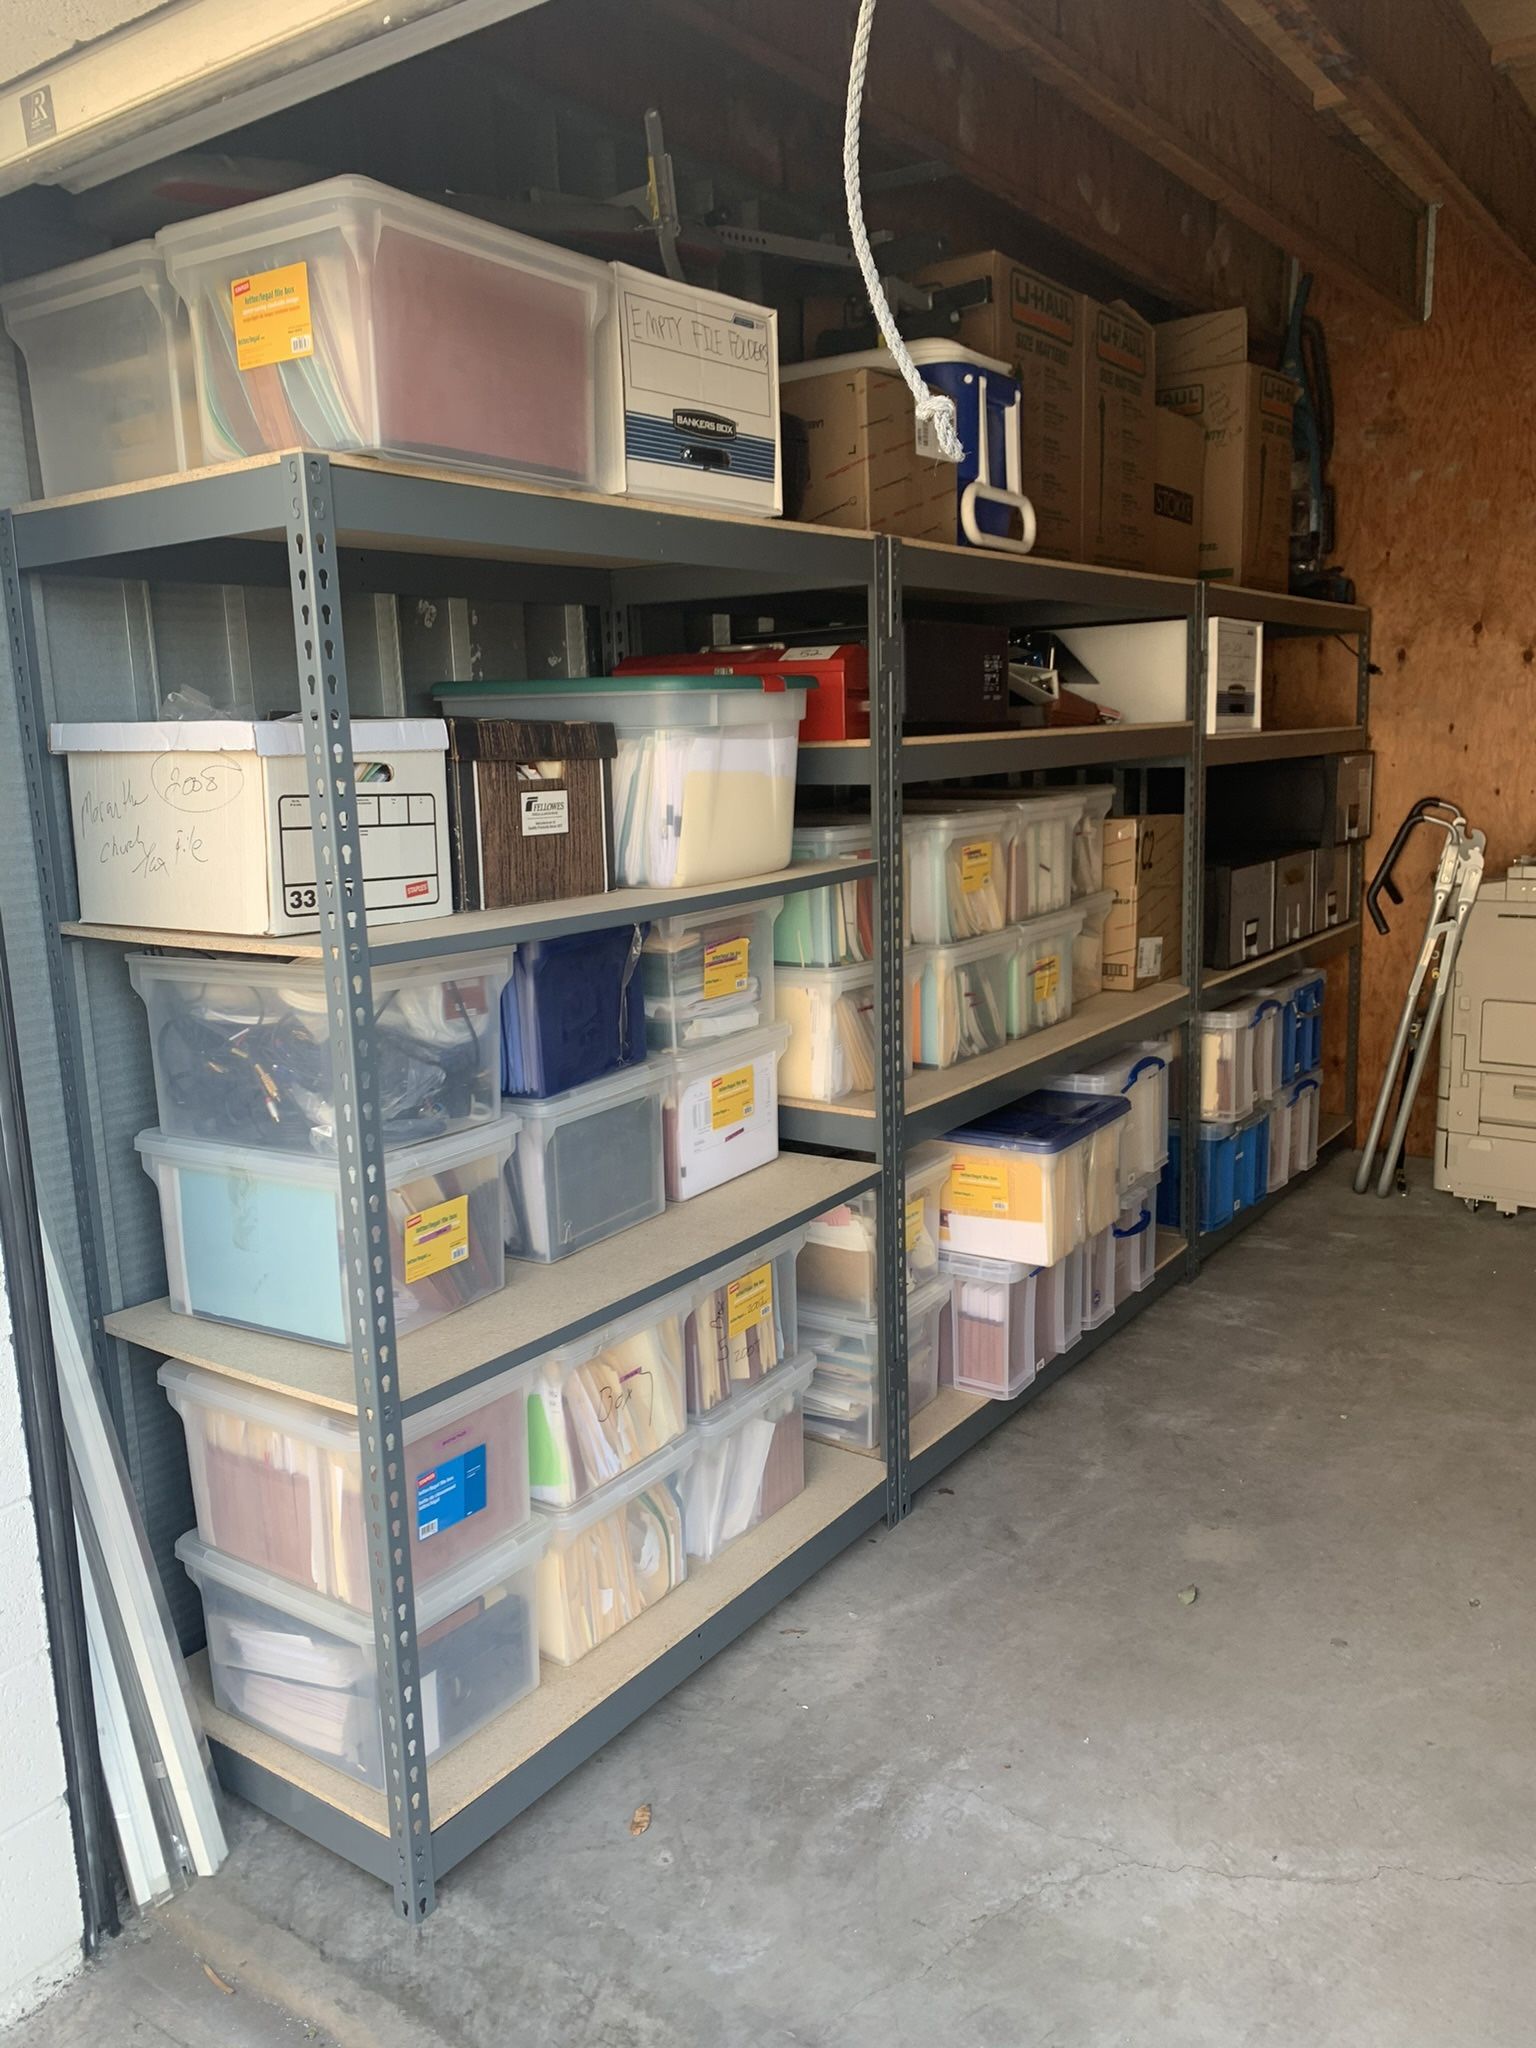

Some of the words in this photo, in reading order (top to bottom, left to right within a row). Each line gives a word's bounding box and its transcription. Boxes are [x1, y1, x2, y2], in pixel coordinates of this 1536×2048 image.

[1015, 278, 1072, 325] U-HAUL
[630, 304, 682, 346] EMPTY
[691, 320, 723, 356] FILE
[676, 415, 716, 432] BANKERS
[716, 423, 734, 435] BOX
[533, 801, 565, 812] FELLOWES
[598, 1386, 632, 1422] Box
